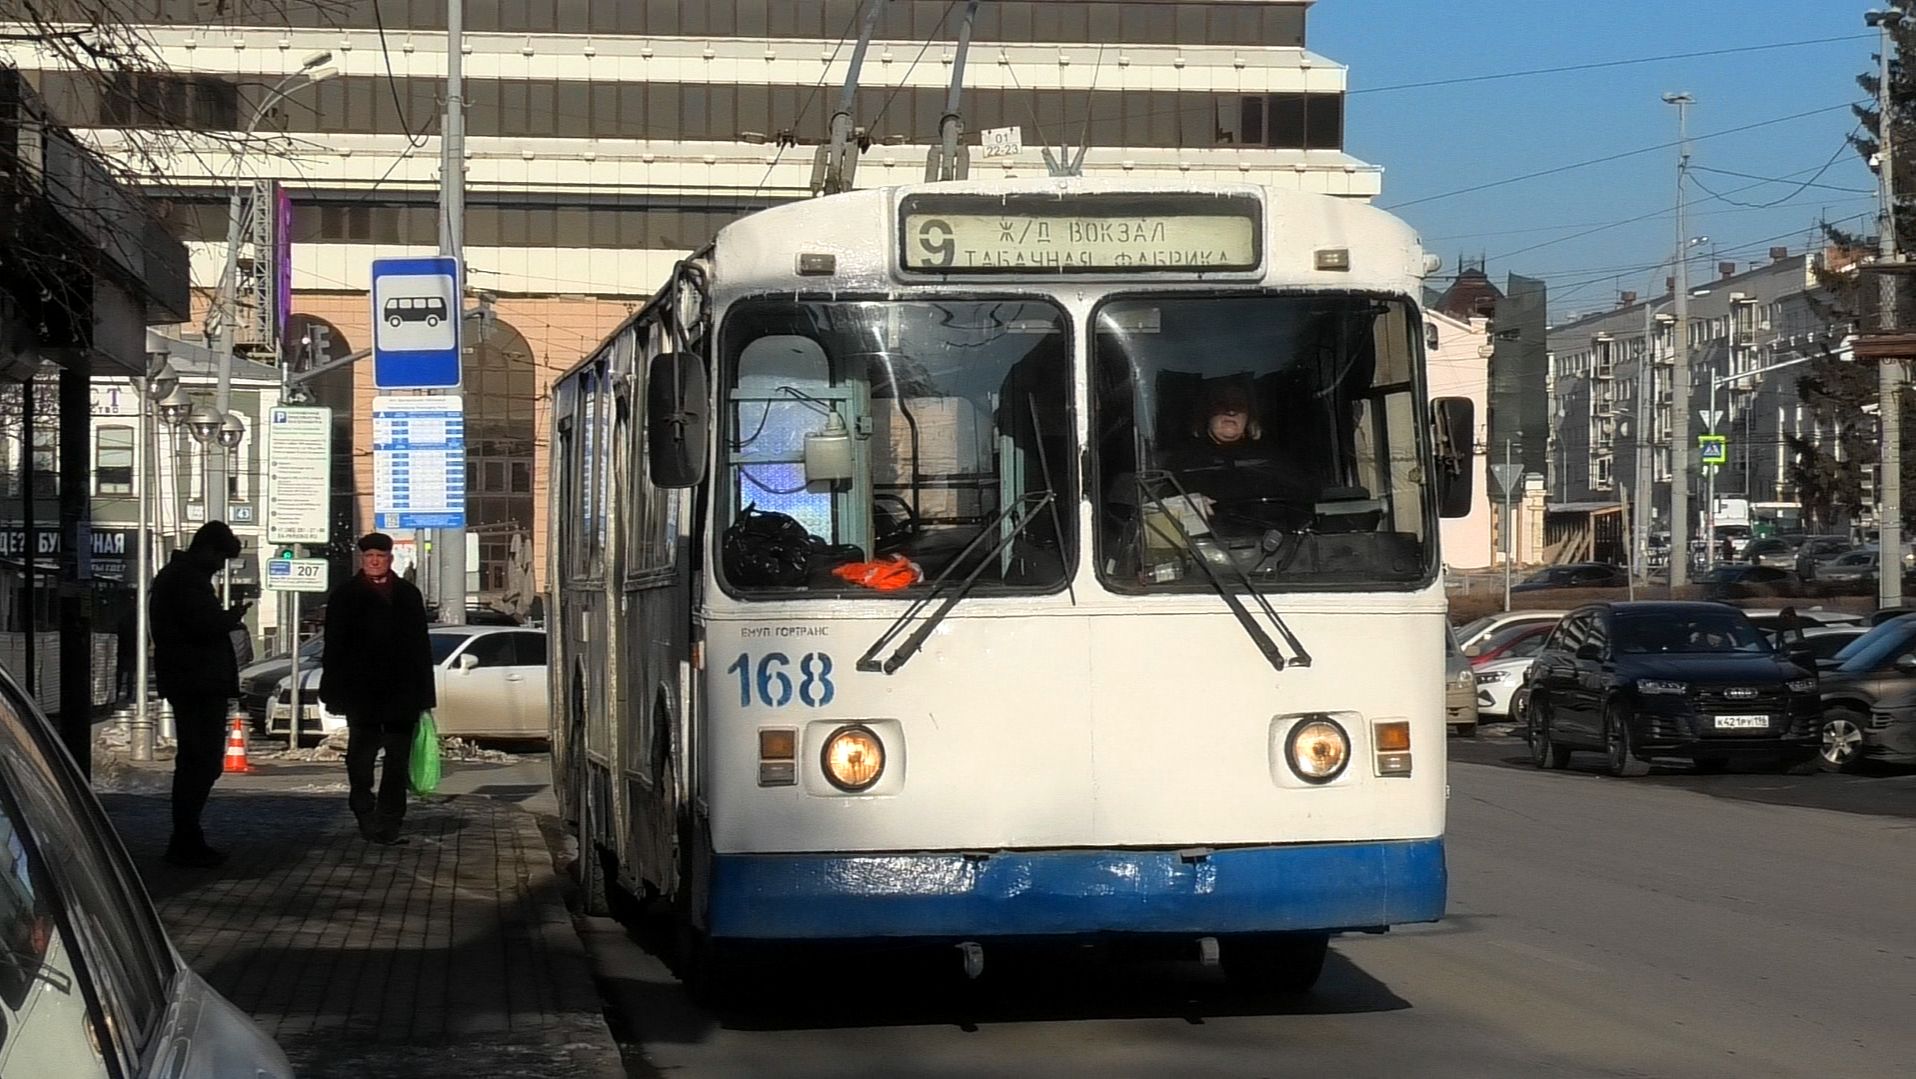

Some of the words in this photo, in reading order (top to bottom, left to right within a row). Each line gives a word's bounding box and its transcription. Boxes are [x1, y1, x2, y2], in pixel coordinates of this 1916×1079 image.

[995, 133, 1009, 144] 01
[986, 144, 1019, 157] 22-23
[999, 221, 1051, 243] Ж/Д
[1069, 221, 1166, 243] ВОКЗАЛ
[919, 219, 955, 267] 9
[964, 250, 1093, 267] ТАБАЧНАЯ
[1114, 250, 1229, 267] ФАБРИКА
[297, 566, 319, 577] 207
[775, 626, 829, 638] ГОРТРАНС
[727, 652, 835, 708] 168
